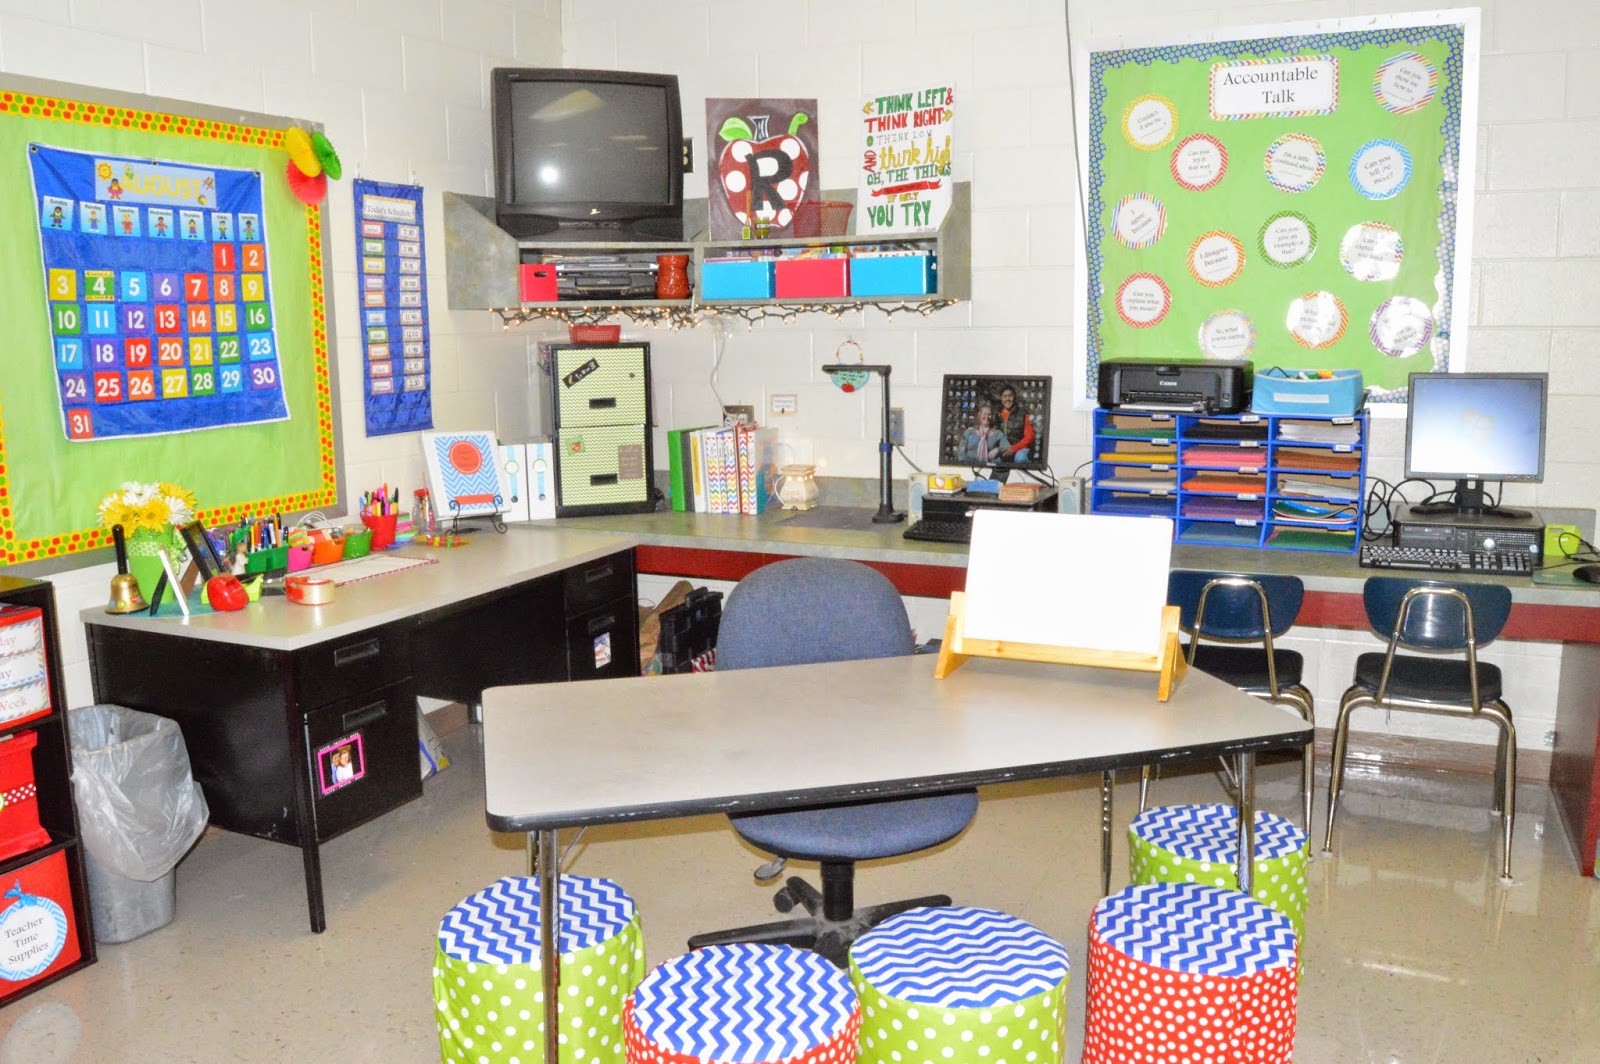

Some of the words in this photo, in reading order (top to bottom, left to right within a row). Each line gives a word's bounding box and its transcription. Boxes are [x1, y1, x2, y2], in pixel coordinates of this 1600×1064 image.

[1222, 66, 1319, 87] Accountable
[875, 93, 914, 114] THINK
[918, 88, 947, 107] LEFT
[945, 87, 954, 106] &
[1261, 88, 1296, 104] Talk
[864, 111, 909, 133] THINK
[913, 107, 944, 127] RIGHT
[877, 132, 909, 146] THINK
[913, 129, 933, 139] LOW
[863, 150, 877, 173] AND
[880, 141, 921, 170] think
[922, 135, 952, 175] high
[744, 149, 793, 211] R
[886, 167, 910, 183] THE
[120, 172, 202, 202] AUGUST
[49, 198, 68, 206] Sunday
[866, 204, 894, 228] YOU
[900, 199, 932, 227] TRY
[222, 248, 227, 265] 1
[249, 249, 259, 267] 2
[57, 275, 69, 295] 3
[93, 276, 106, 295] 4
[129, 278, 140, 296] 5
[160, 278, 172, 296] 6
[191, 279, 202, 296] 7
[220, 279, 230, 296] 8
[248, 279, 257, 296] 9
[58, 310, 76, 329] 10
[95, 310, 109, 328] 11
[128, 310, 145, 328] 12
[159, 310, 176, 328] 13
[191, 310, 207, 328] 14
[219, 309, 233, 327] 15
[250, 308, 265, 325] 16
[61, 344, 77, 363] 17
[96, 345, 114, 363] 18
[130, 344, 147, 363] 19
[160, 343, 182, 361] 20
[193, 344, 209, 362] 21
[220, 340, 238, 358] 22
[251, 338, 271, 355] 23
[66, 379, 86, 398] 24
[97, 378, 119, 397] 25
[130, 376, 152, 395] 26
[164, 375, 185, 394] 27
[194, 373, 213, 390] 28
[222, 369, 240, 388] 29
[253, 367, 275, 385] 30
[73, 415, 90, 434] 31
[4, 917, 44, 939] Teacher
[13, 932, 38, 948] Time
[8, 942, 49, 965] Supplies
